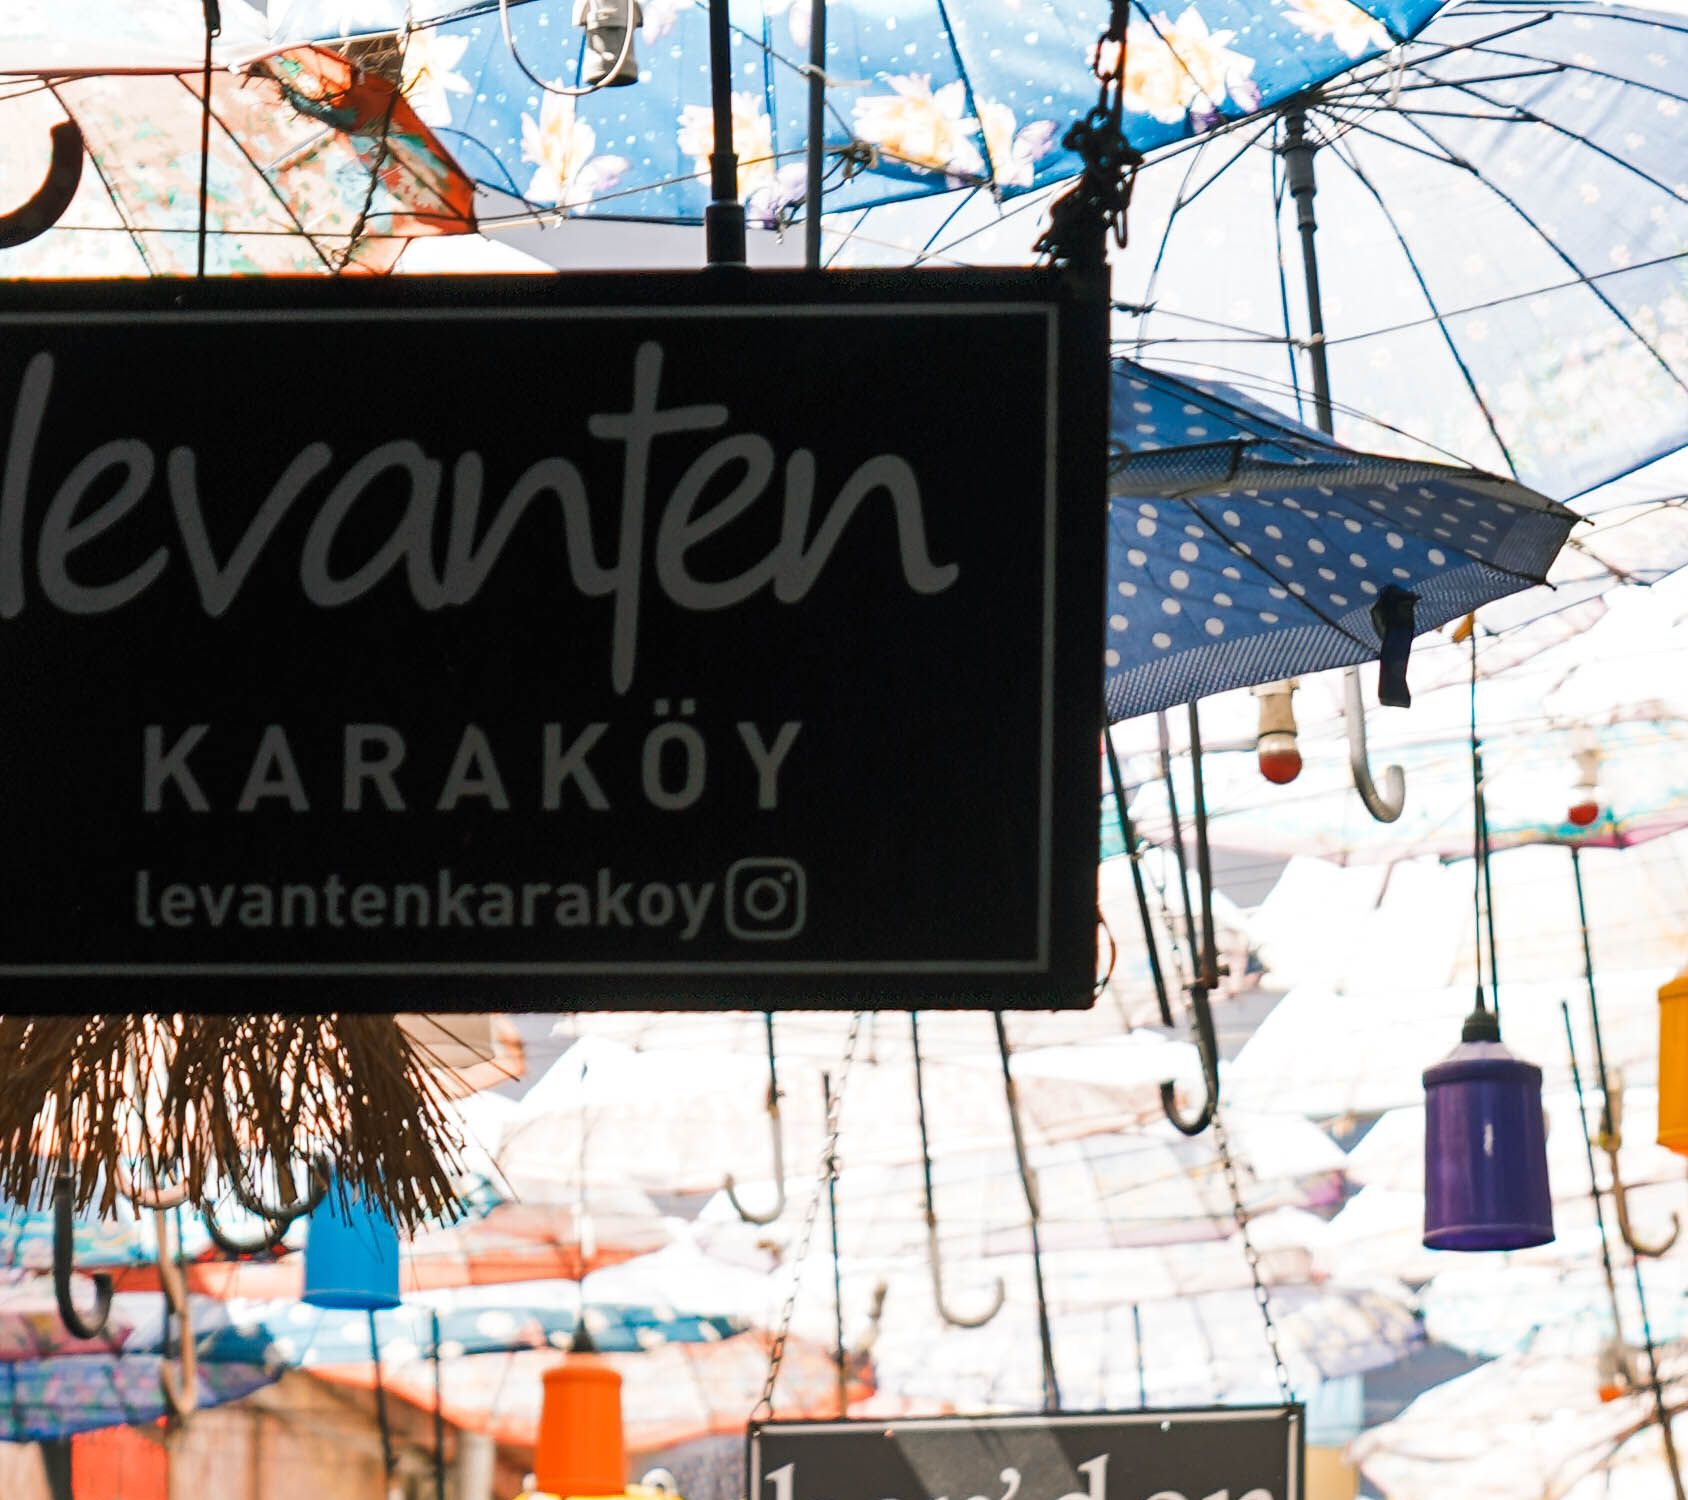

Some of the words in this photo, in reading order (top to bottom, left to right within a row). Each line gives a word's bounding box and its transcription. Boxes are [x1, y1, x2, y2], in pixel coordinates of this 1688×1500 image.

[0, 340, 960, 696] levanten
[143, 698, 803, 813] KARAKÖY
[136, 866, 716, 942] levantenkarakoy
